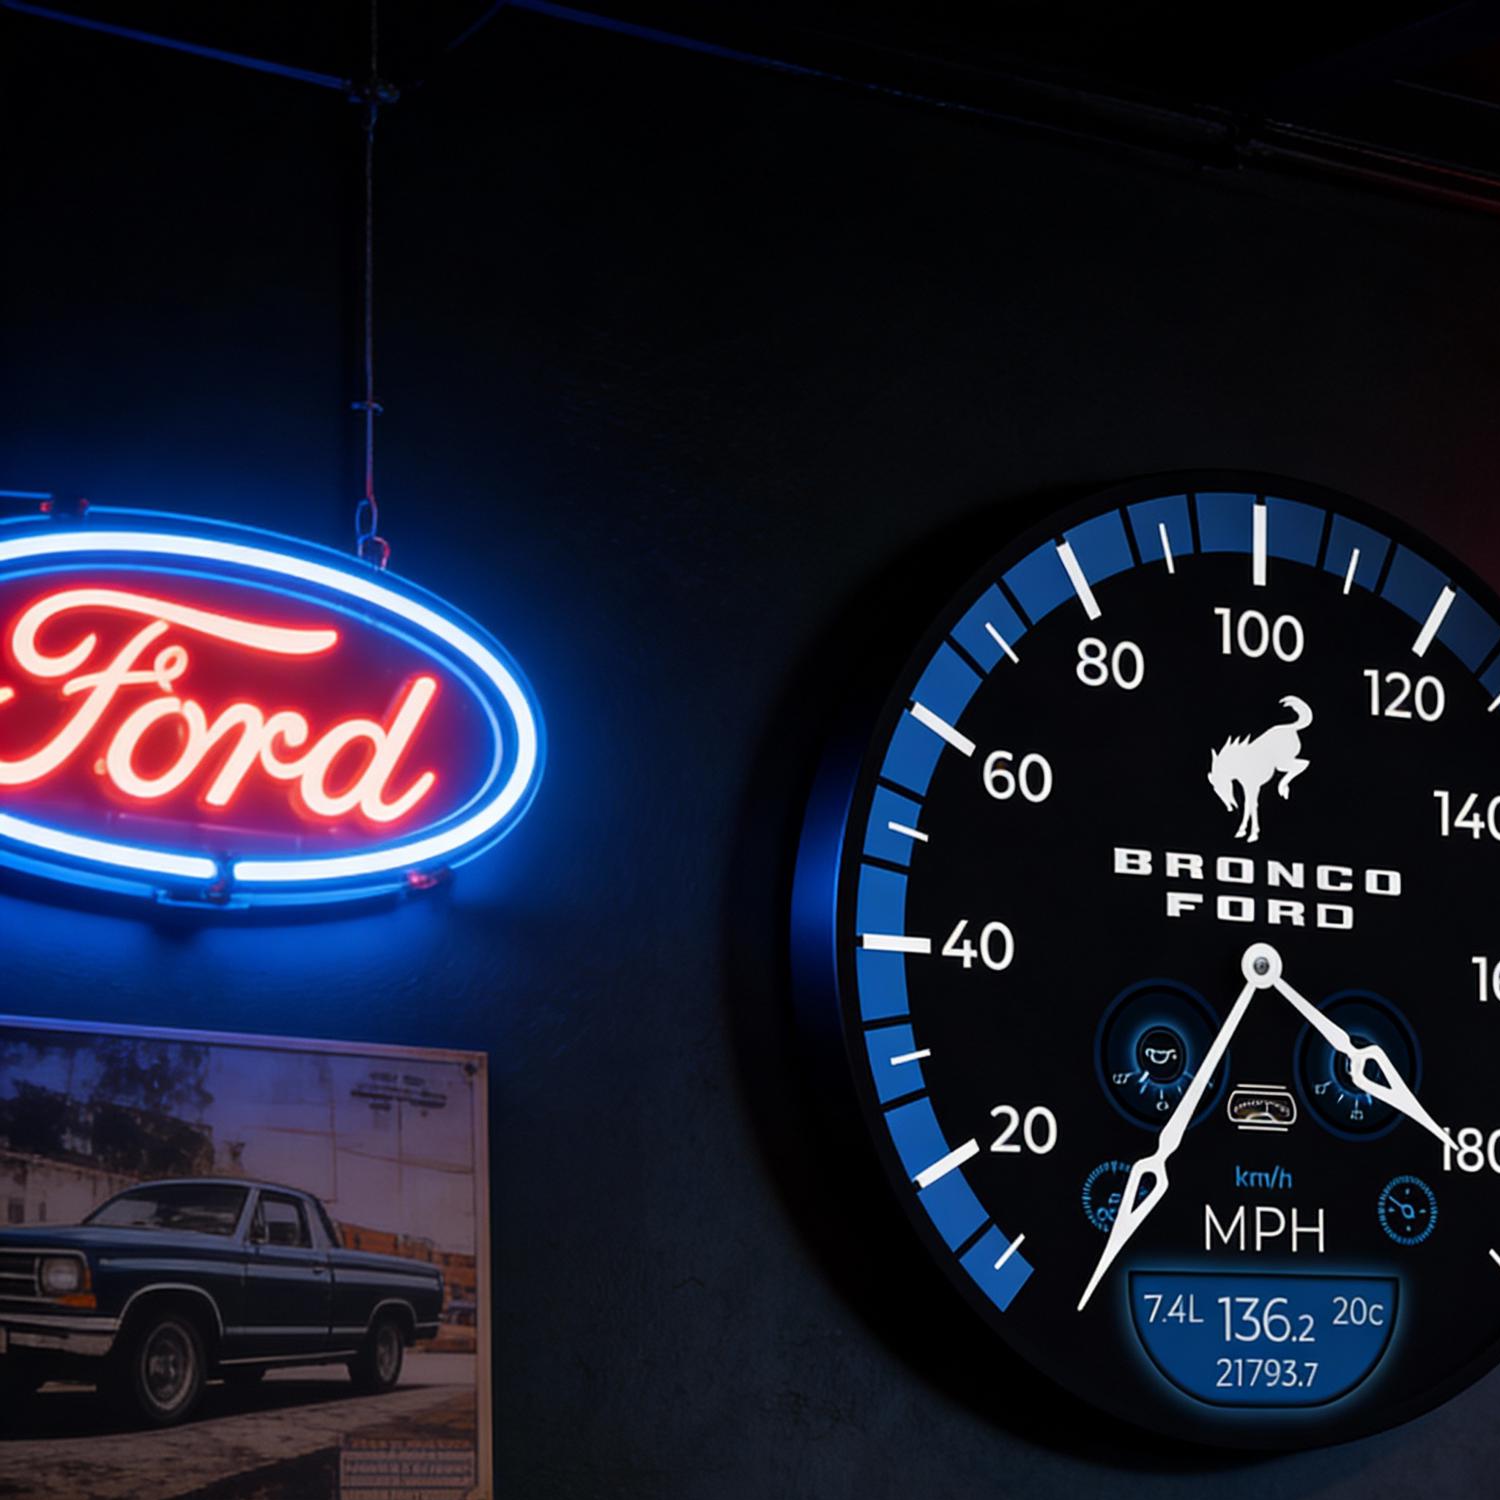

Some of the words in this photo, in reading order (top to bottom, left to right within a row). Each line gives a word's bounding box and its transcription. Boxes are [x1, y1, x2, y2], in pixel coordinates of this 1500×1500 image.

[1213, 607, 1304, 663] 100
[1076, 637, 1145, 690] 80
[0, 588, 437, 822] Ford
[1363, 669, 1445, 722] 120
[983, 750, 1053, 803] 60
[1113, 847, 1402, 897] BRONCO
[1166, 892, 1354, 930] FORD
[941, 919, 1015, 971] 40
[990, 1104, 1058, 1155] 20
[1234, 1165, 1293, 1189] km/h
[1204, 1203, 1325, 1253] MPH
[1143, 1294, 1205, 1324] 7.4L
[1217, 1296, 1315, 1342] 136.2
[1216, 1358, 1318, 1387] 21793.7
